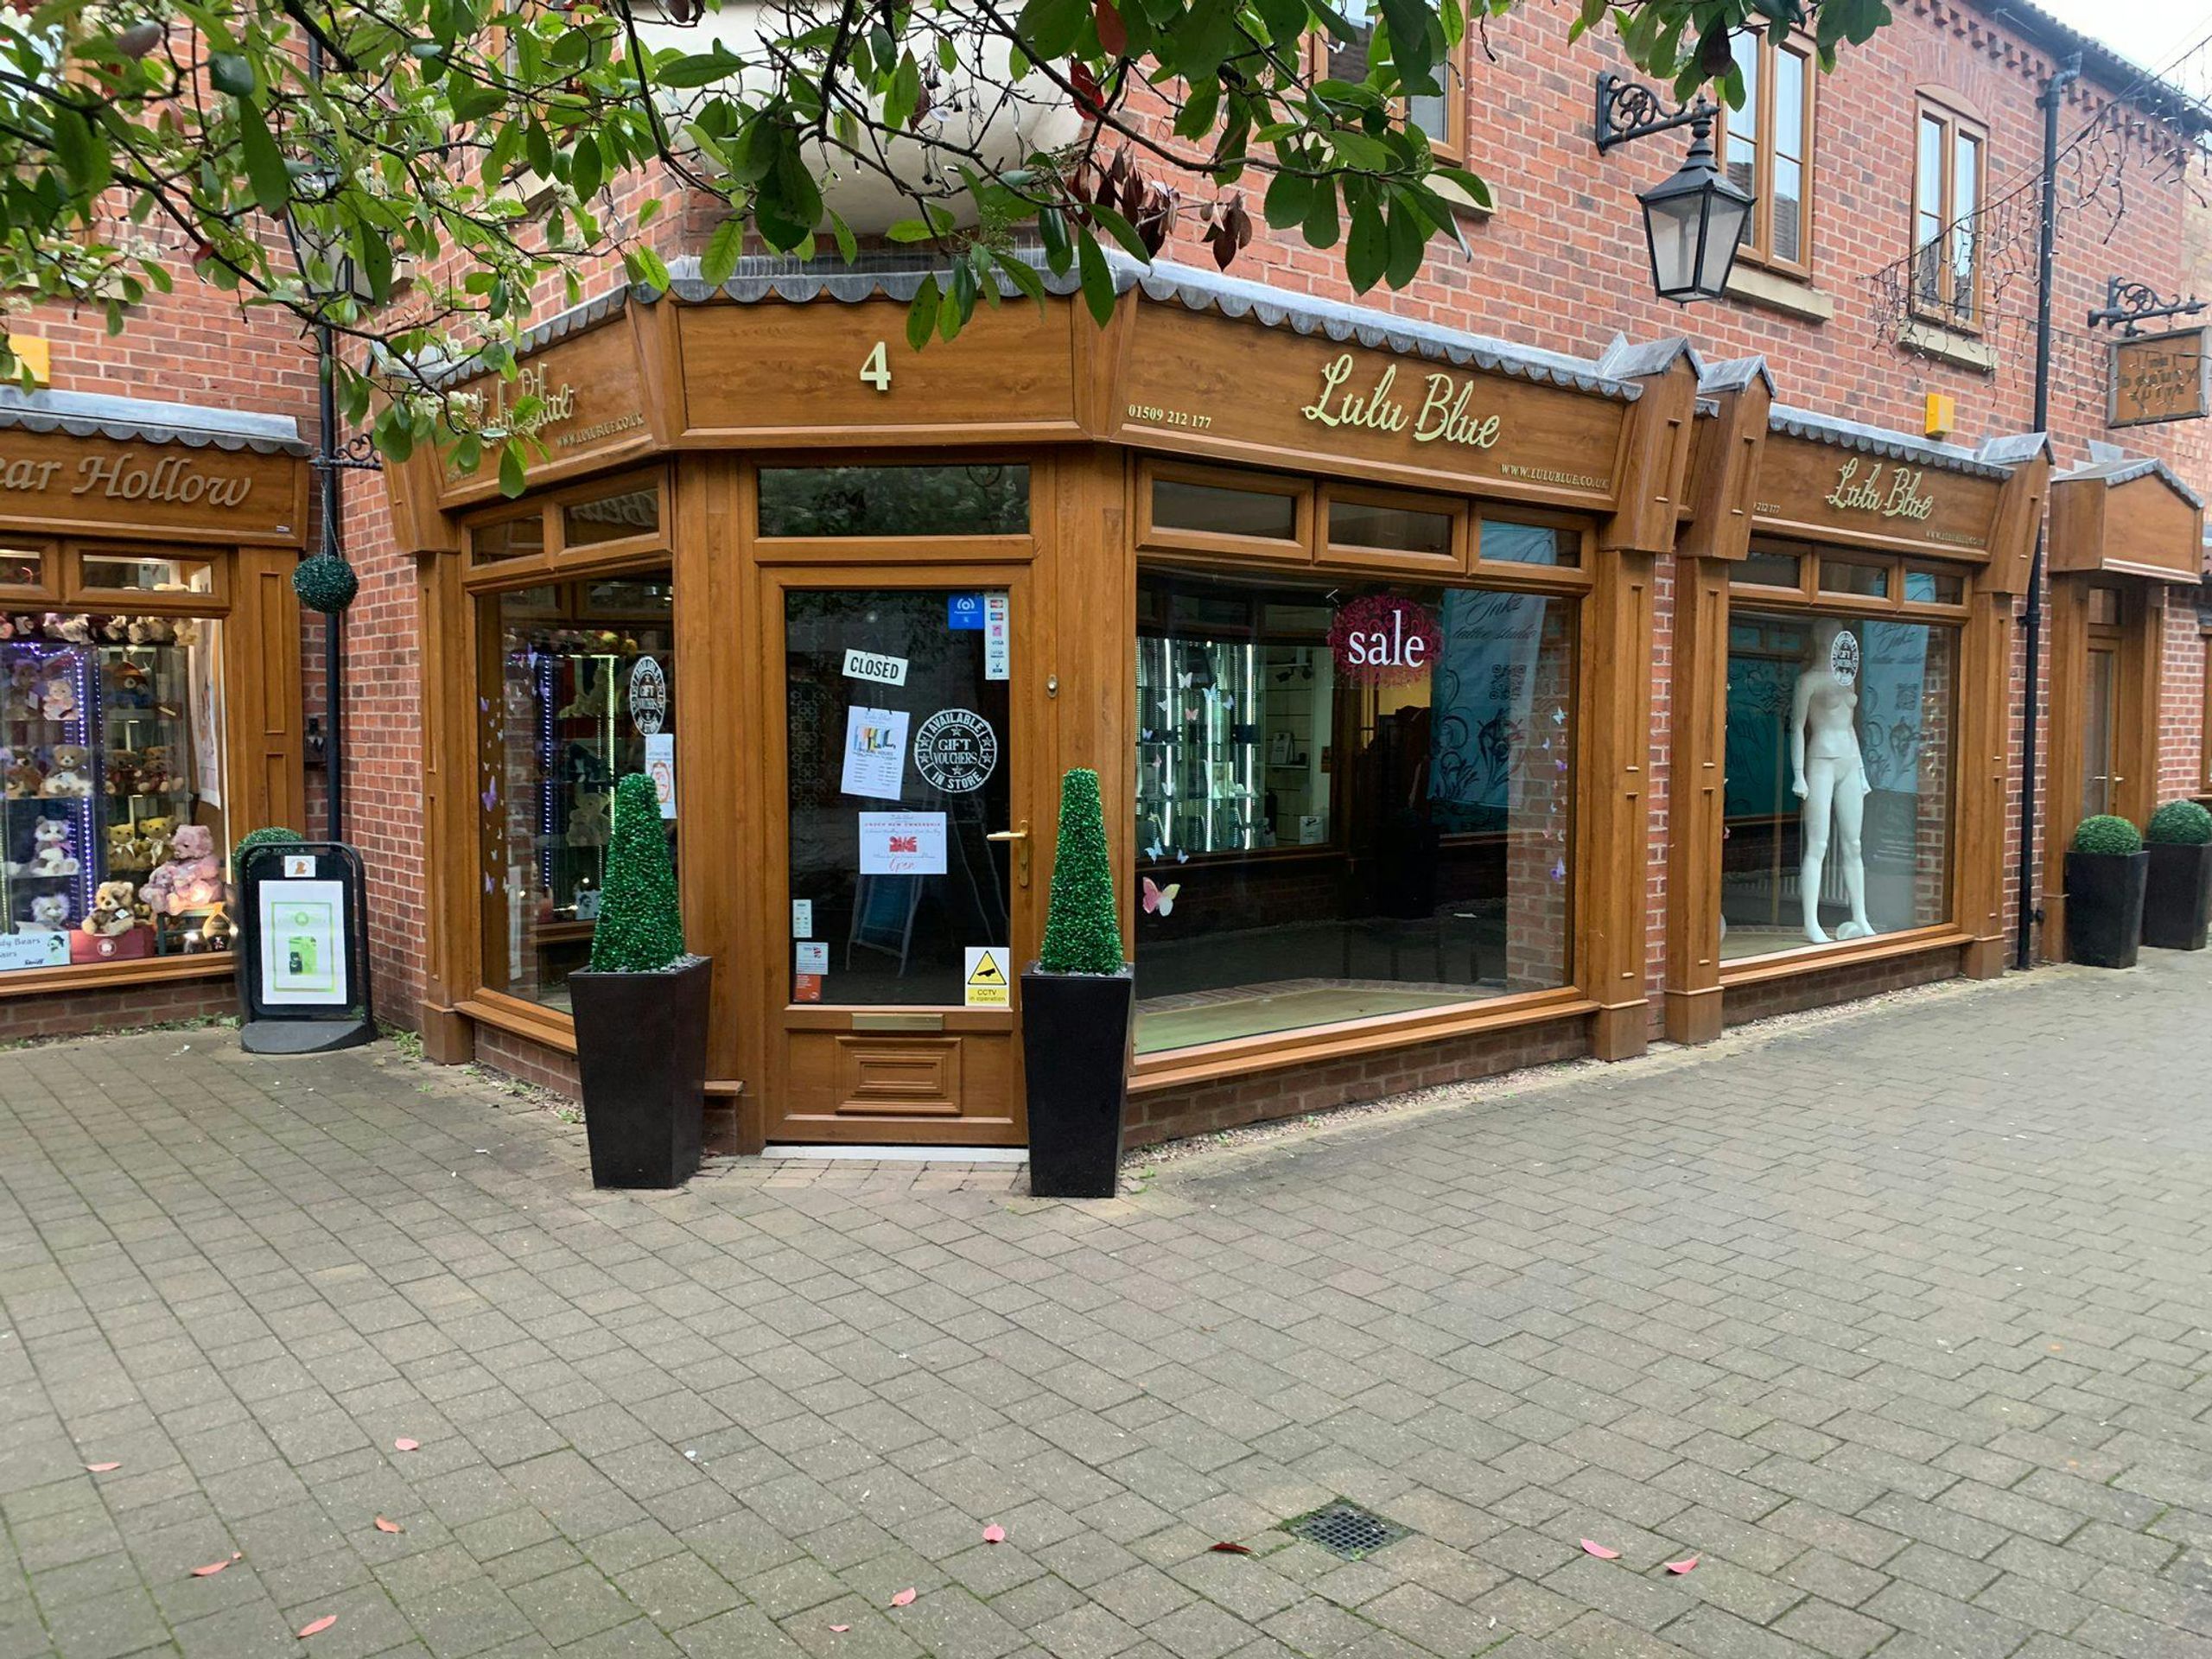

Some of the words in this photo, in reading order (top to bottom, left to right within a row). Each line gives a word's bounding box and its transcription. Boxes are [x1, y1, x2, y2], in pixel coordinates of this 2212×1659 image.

[860, 341, 892, 391] 4
[1302, 353, 1409, 432] Lulu
[1414, 372, 1501, 449] Blue
[1128, 404, 1164, 421] 01509
[1167, 410, 1188, 425] 212
[1192, 414, 1211, 429] 177
[0, 455, 63, 491] ar
[71, 453, 251, 507] Hollow
[1825, 457, 1882, 509] Lulu
[1882, 467, 1934, 519] Blue
[1348, 609, 1425, 668] sale
[850, 657, 899, 679] CLOSED
[928, 713, 984, 734] AVAILABLE
[938, 739, 972, 751] GIFT
[933, 752, 978, 765] VOUCHERS
[931, 772, 946, 785] IN
[947, 771, 982, 789] STORE
